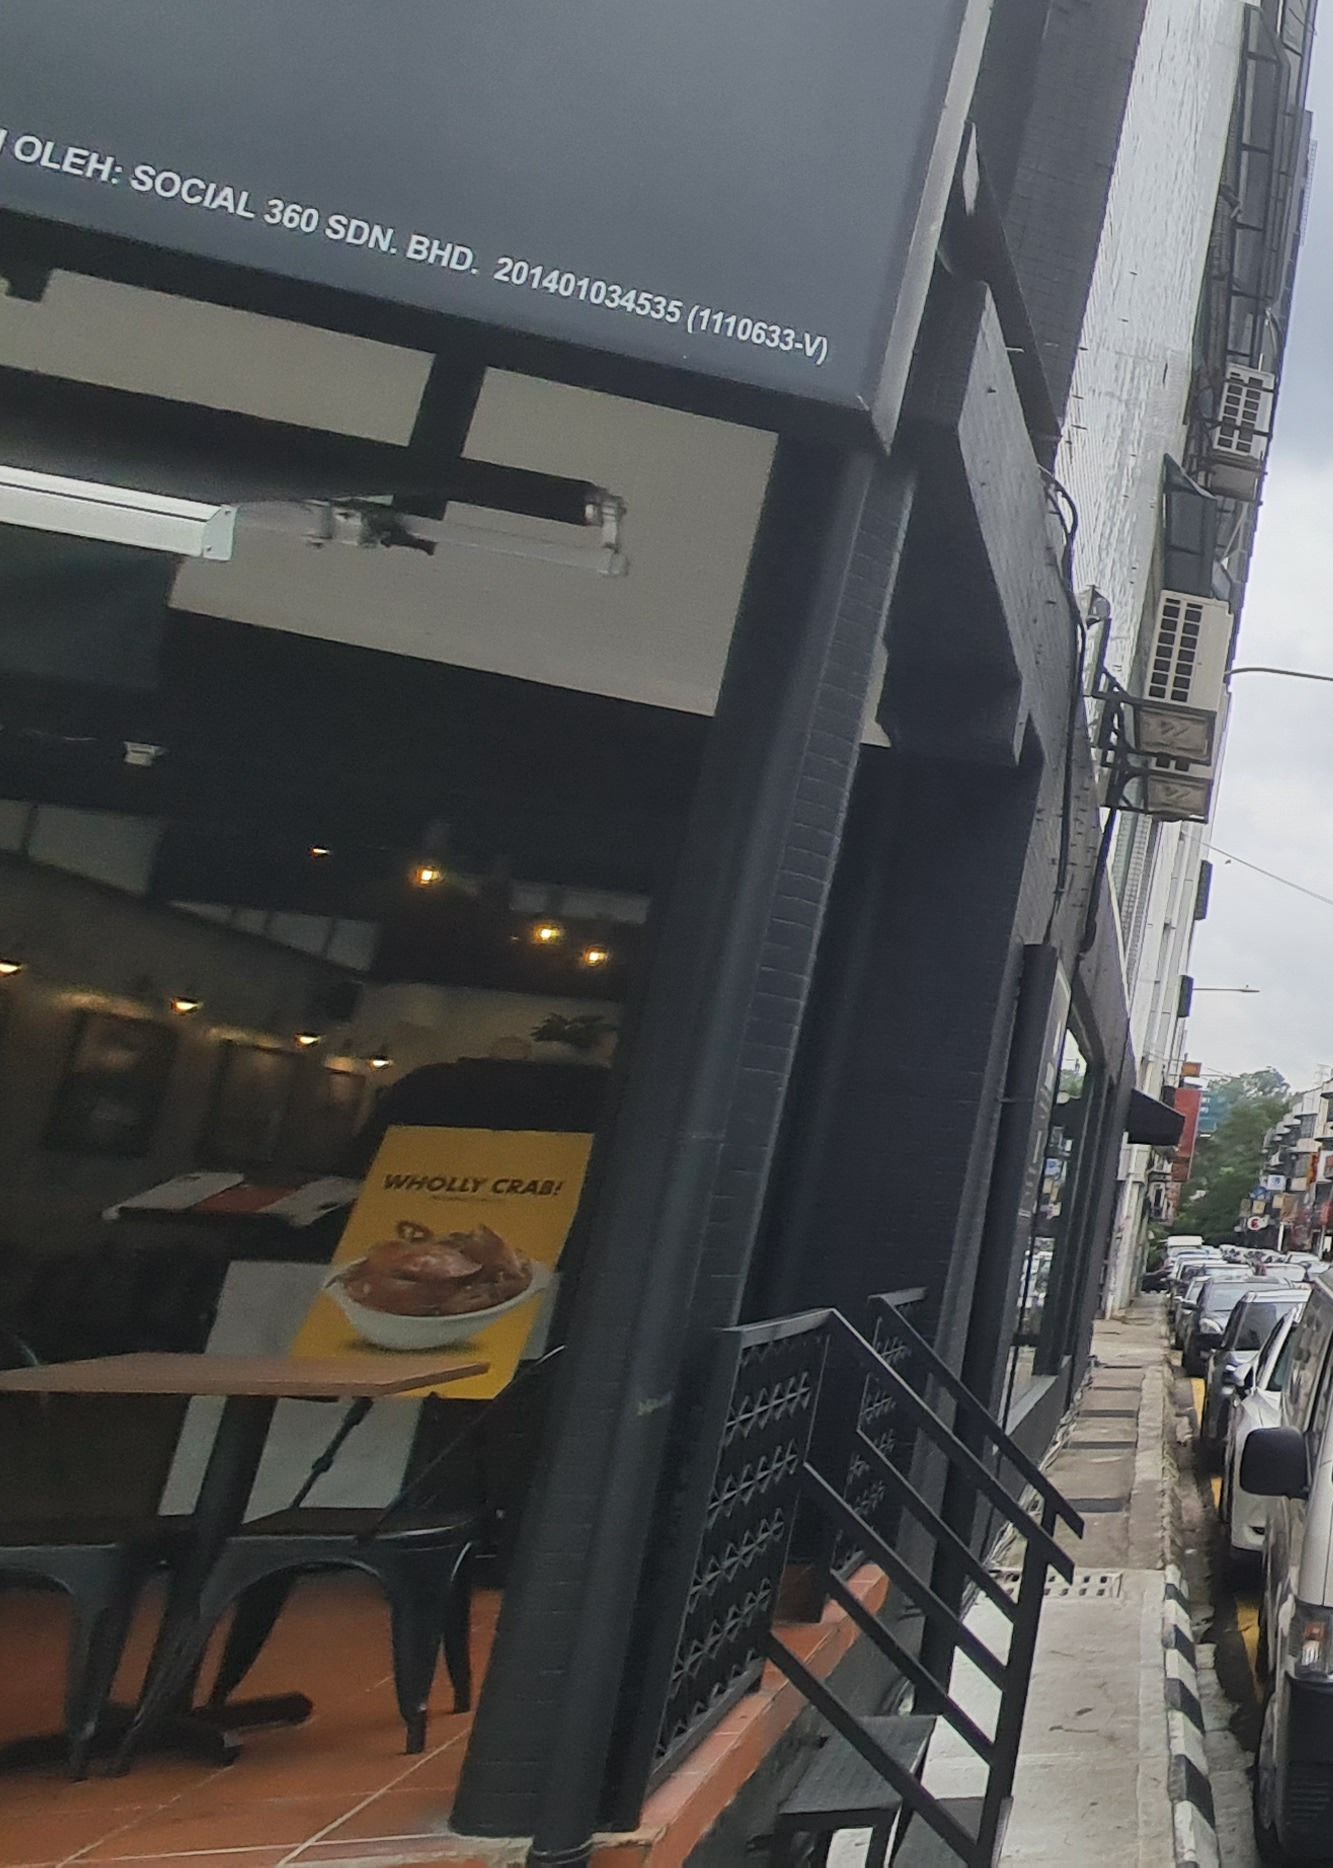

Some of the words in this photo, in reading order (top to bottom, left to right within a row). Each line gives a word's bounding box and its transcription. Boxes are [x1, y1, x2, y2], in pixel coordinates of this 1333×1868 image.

[14, 134, 123, 185] OLEH:
[130, 163, 255, 219] SOCIAL
[263, 198, 319, 234] 360
[324, 213, 398, 256] SDN.
[406, 233, 480, 276] BHD.
[493, 255, 683, 324] 201401034535
[686, 303, 830, 365] (1110633-V)
[383, 1174, 486, 1193] WHOLLY
[491, 1178, 565, 1196] CRAB!
